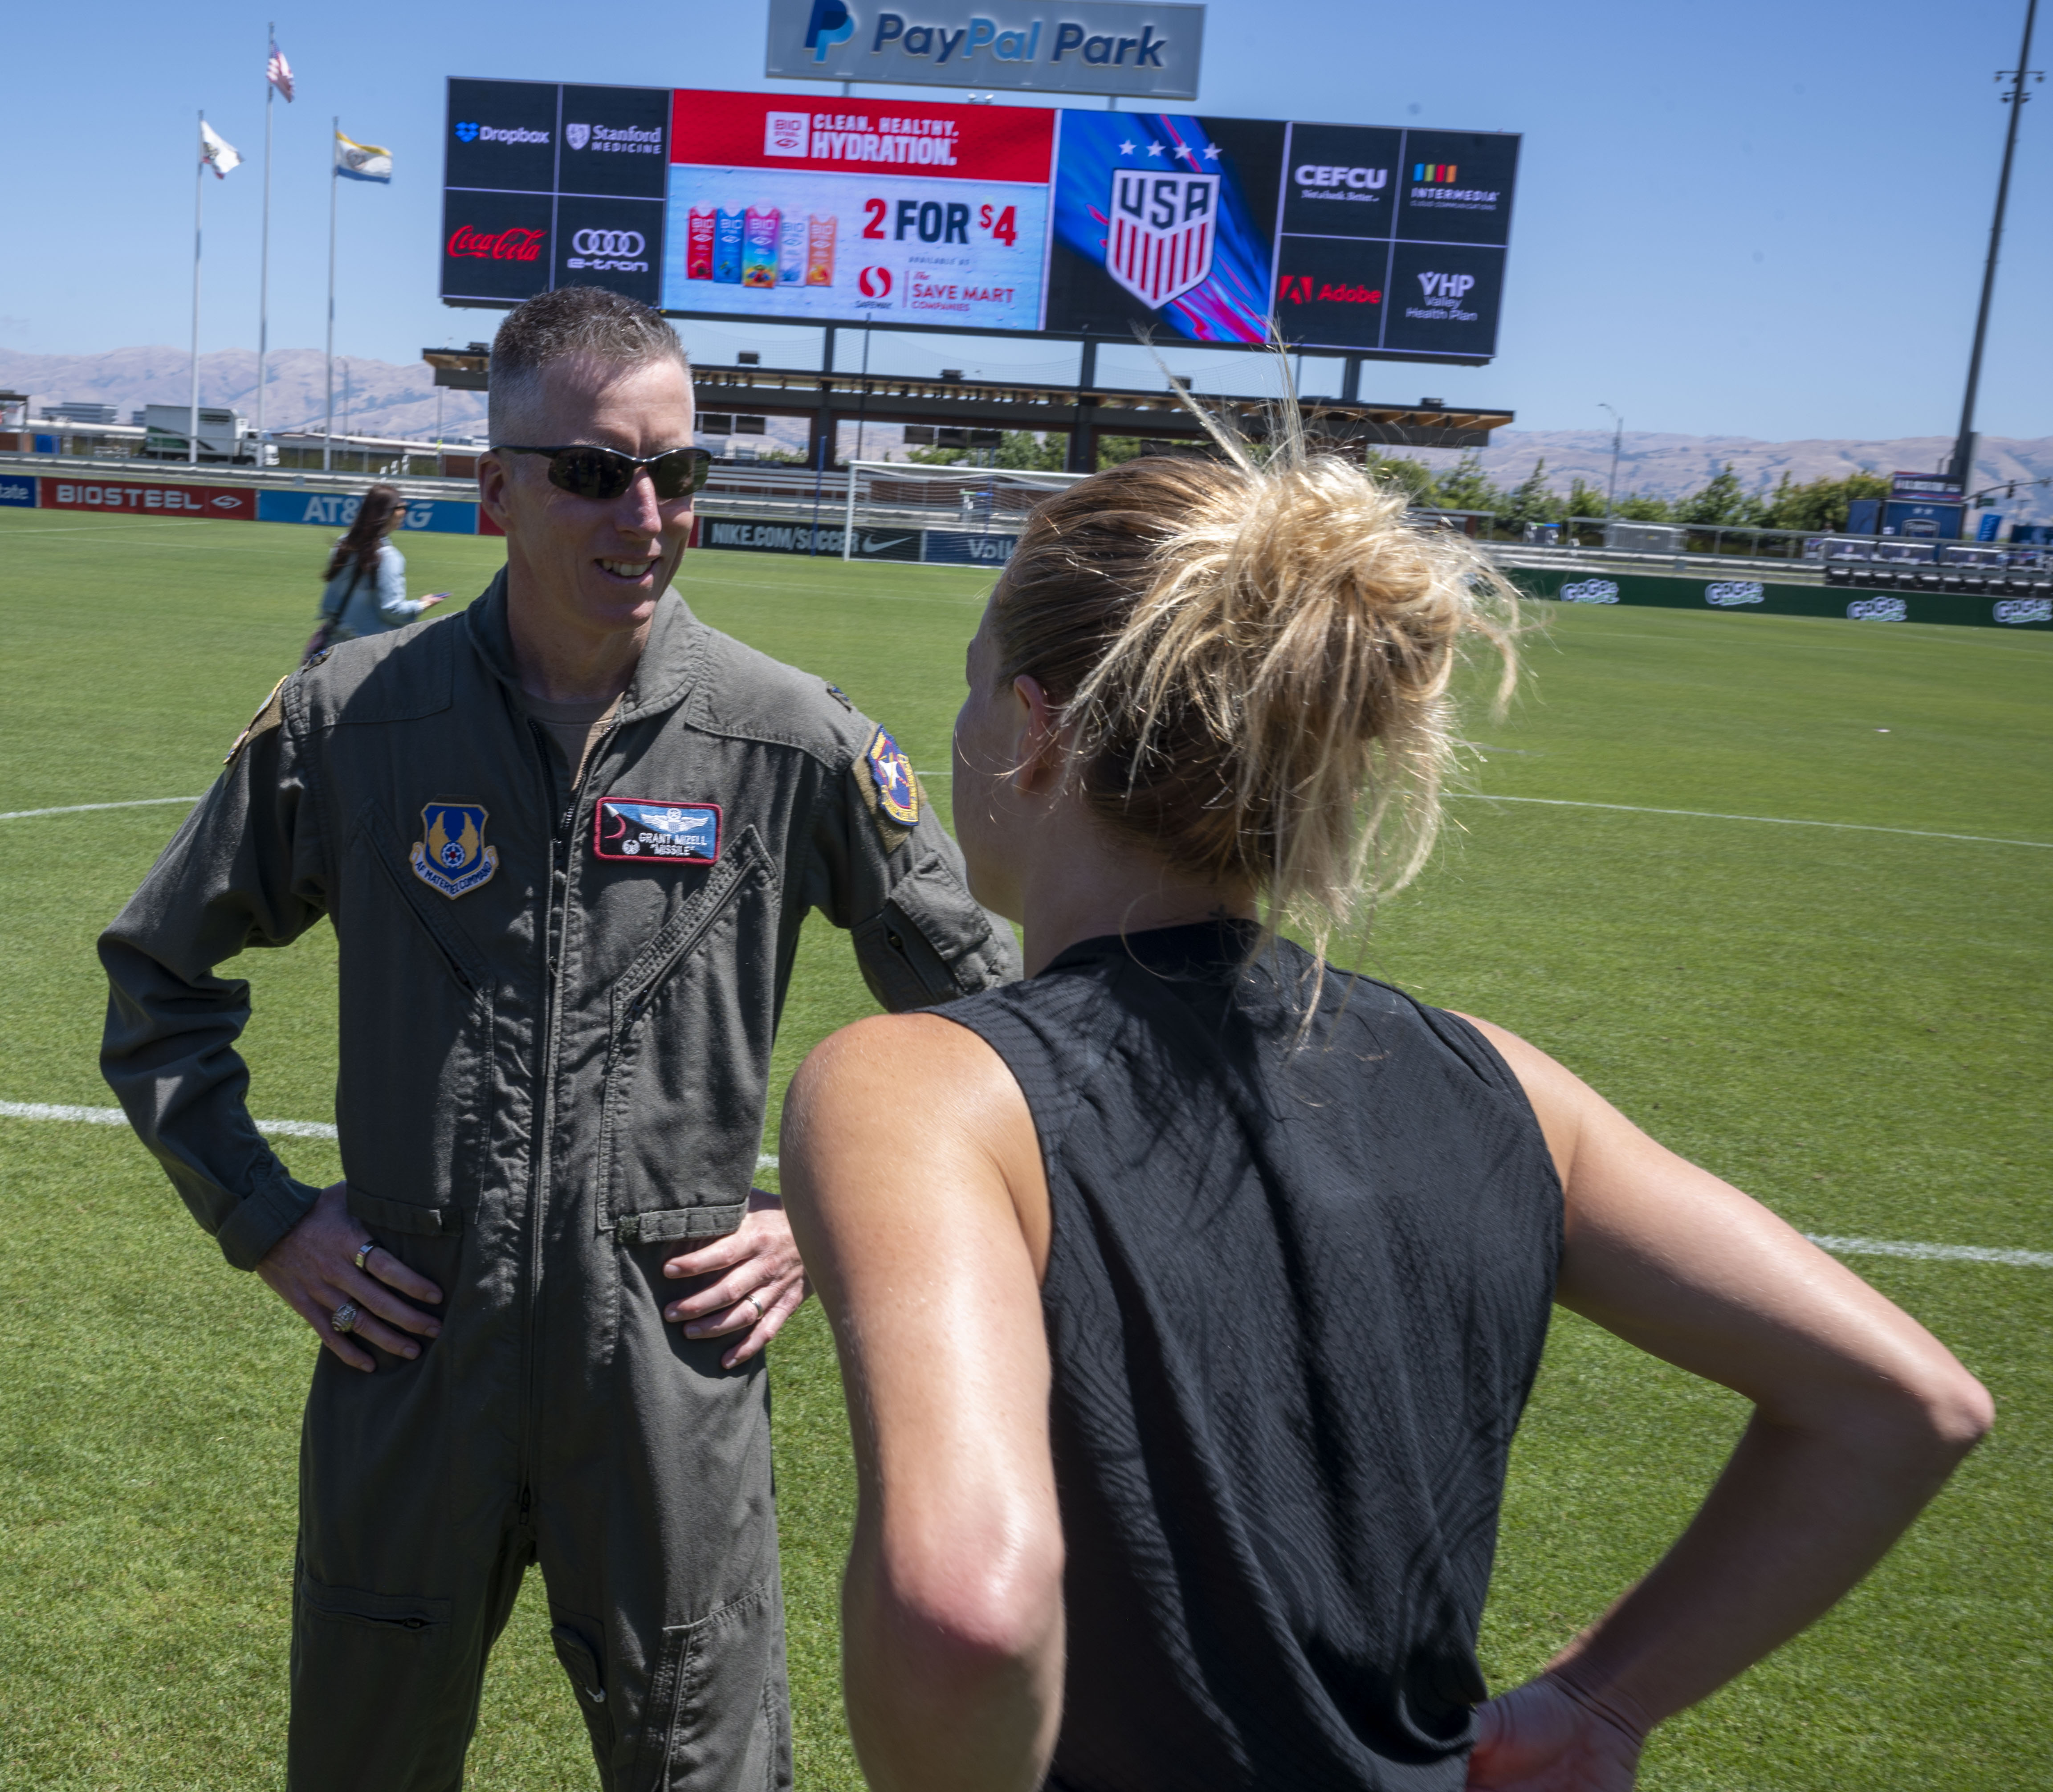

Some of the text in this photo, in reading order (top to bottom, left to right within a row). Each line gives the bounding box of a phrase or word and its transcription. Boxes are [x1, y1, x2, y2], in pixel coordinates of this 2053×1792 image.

[872, 12, 1168, 68] PayPal Park
[479, 126, 550, 145] Dropbox
[592, 125, 662, 143] Stanford
[774, 119, 801, 131] BIO
[813, 114, 959, 137] CLEAN. HEALTHY.
[591, 142, 662, 155] MEDICINE
[811, 131, 958, 166] HYDRATION.
[1295, 164, 1388, 189] CEFCU
[1119, 178, 1213, 230] USA
[1411, 187, 1498, 202] INTERMEDIA
[862, 198, 1018, 247] 2 FOR $4
[448, 225, 547, 262] Coca-Cola
[912, 284, 1016, 303] SAVE MART
[1317, 284, 1382, 304] Adobe
[1417, 271, 1475, 297] VHP
[911, 301, 970, 312] COMPANIES
[1423, 296, 1463, 310] Valley
[1405, 307, 1478, 322] Health Plan
[56, 484, 204, 510] BIOSTEEL
[302, 496, 362, 524] AT&
[968, 538, 1016, 560] Volk
[638, 832, 672, 844] GRANT
